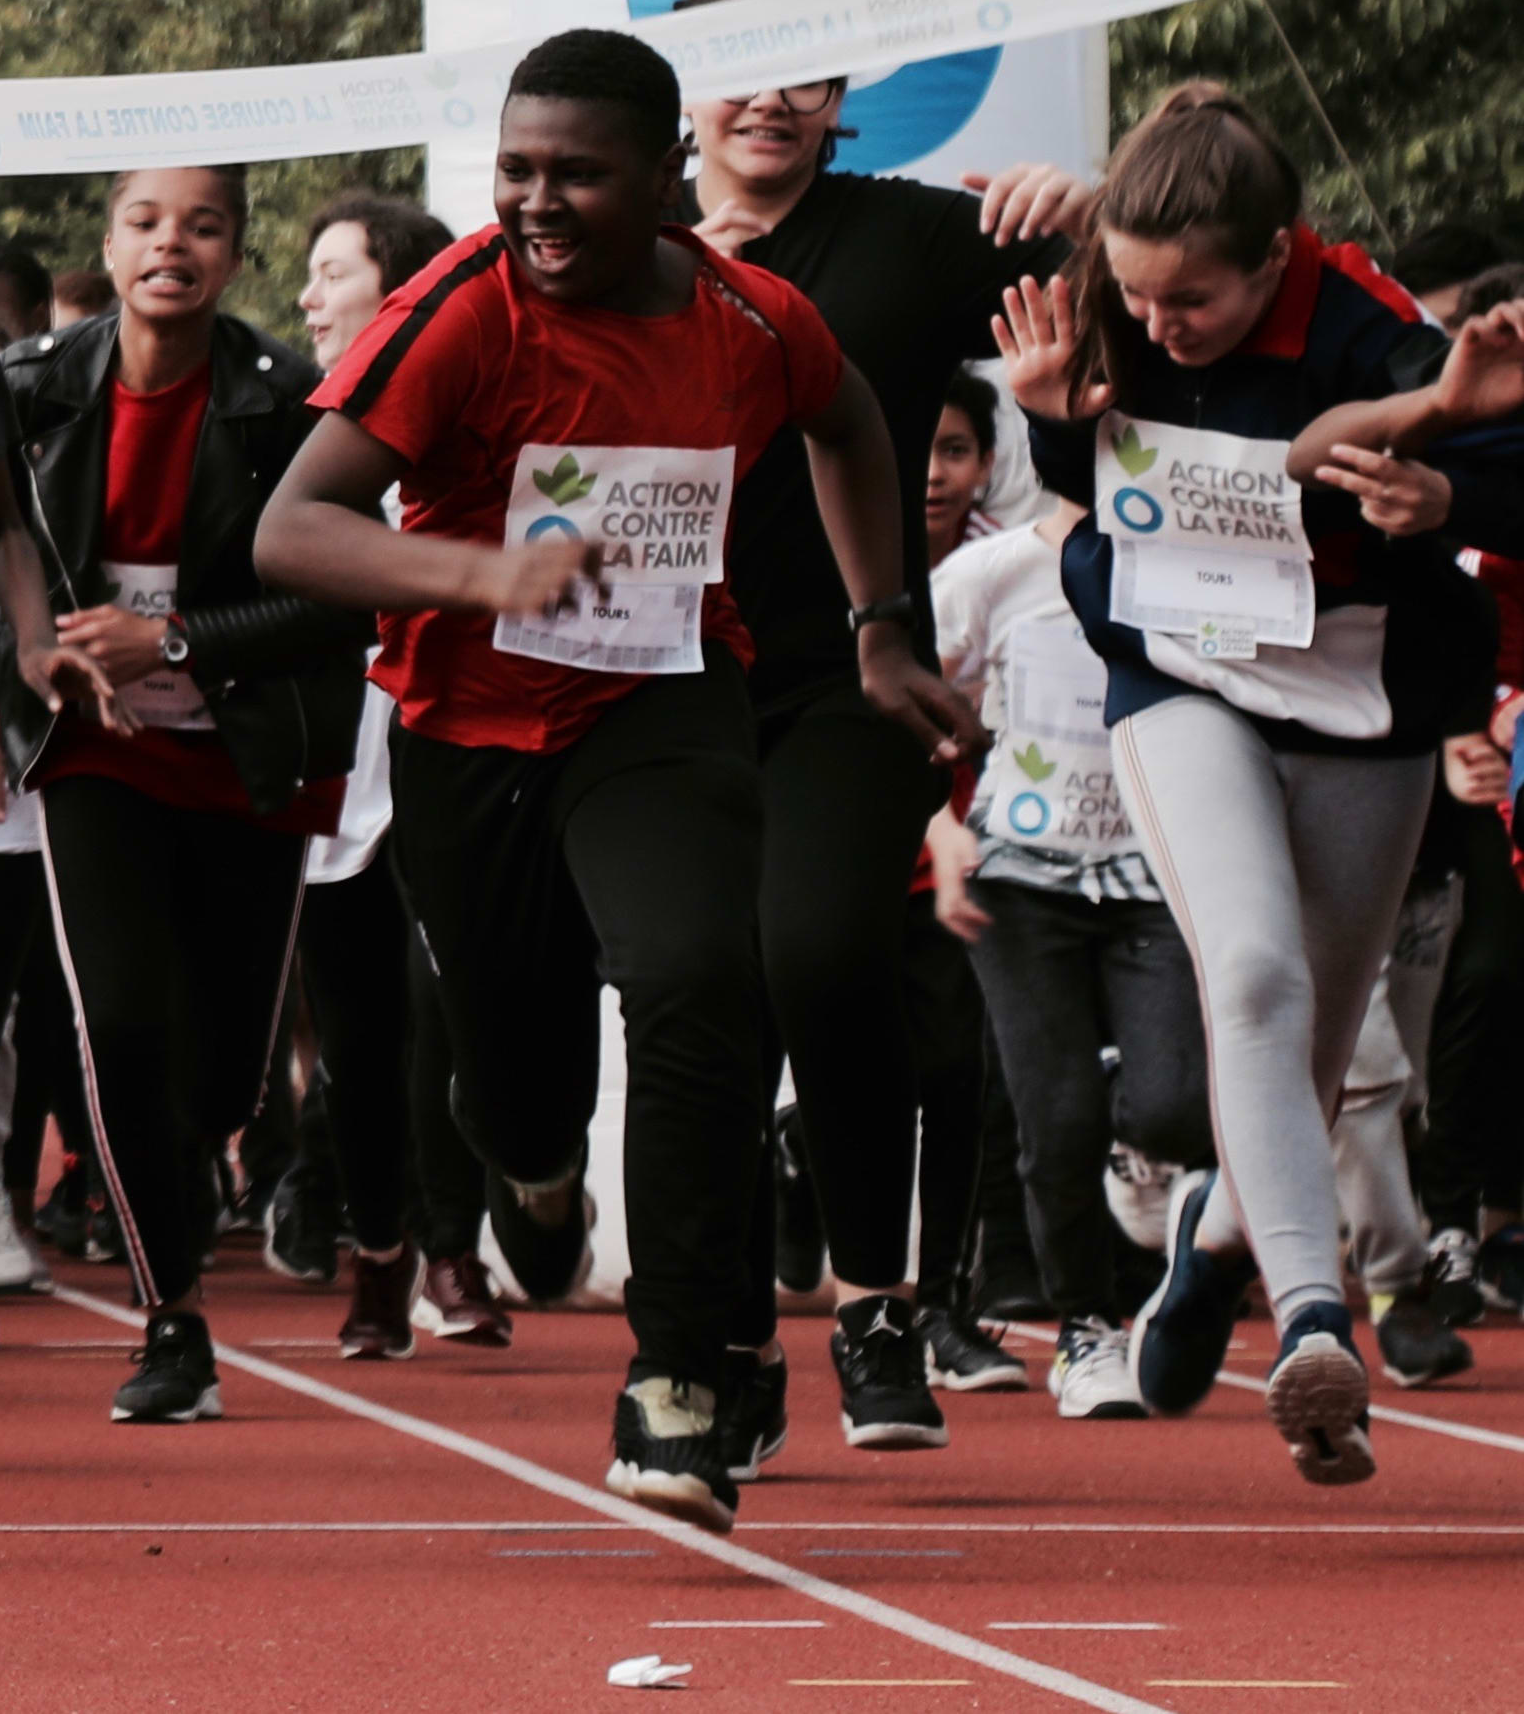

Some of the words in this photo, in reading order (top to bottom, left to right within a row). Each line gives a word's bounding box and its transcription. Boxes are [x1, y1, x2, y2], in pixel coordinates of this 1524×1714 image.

[1168, 459, 1284, 495] ACTION
[605, 481, 720, 507] ACTION
[1170, 487, 1286, 524] CONTRE
[601, 511, 714, 536] CONTRE
[1175, 510, 1212, 534] LA
[1218, 519, 1296, 544] FAIM
[642, 541, 707, 567] FAIM
[1197, 571, 1233, 585] TOURS
[593, 607, 630, 619] TOURS
[1077, 698, 1102, 708] TOUR
[1065, 771, 1113, 792] ACT
[1064, 795, 1120, 816] CON
[1060, 820, 1090, 839] LA
